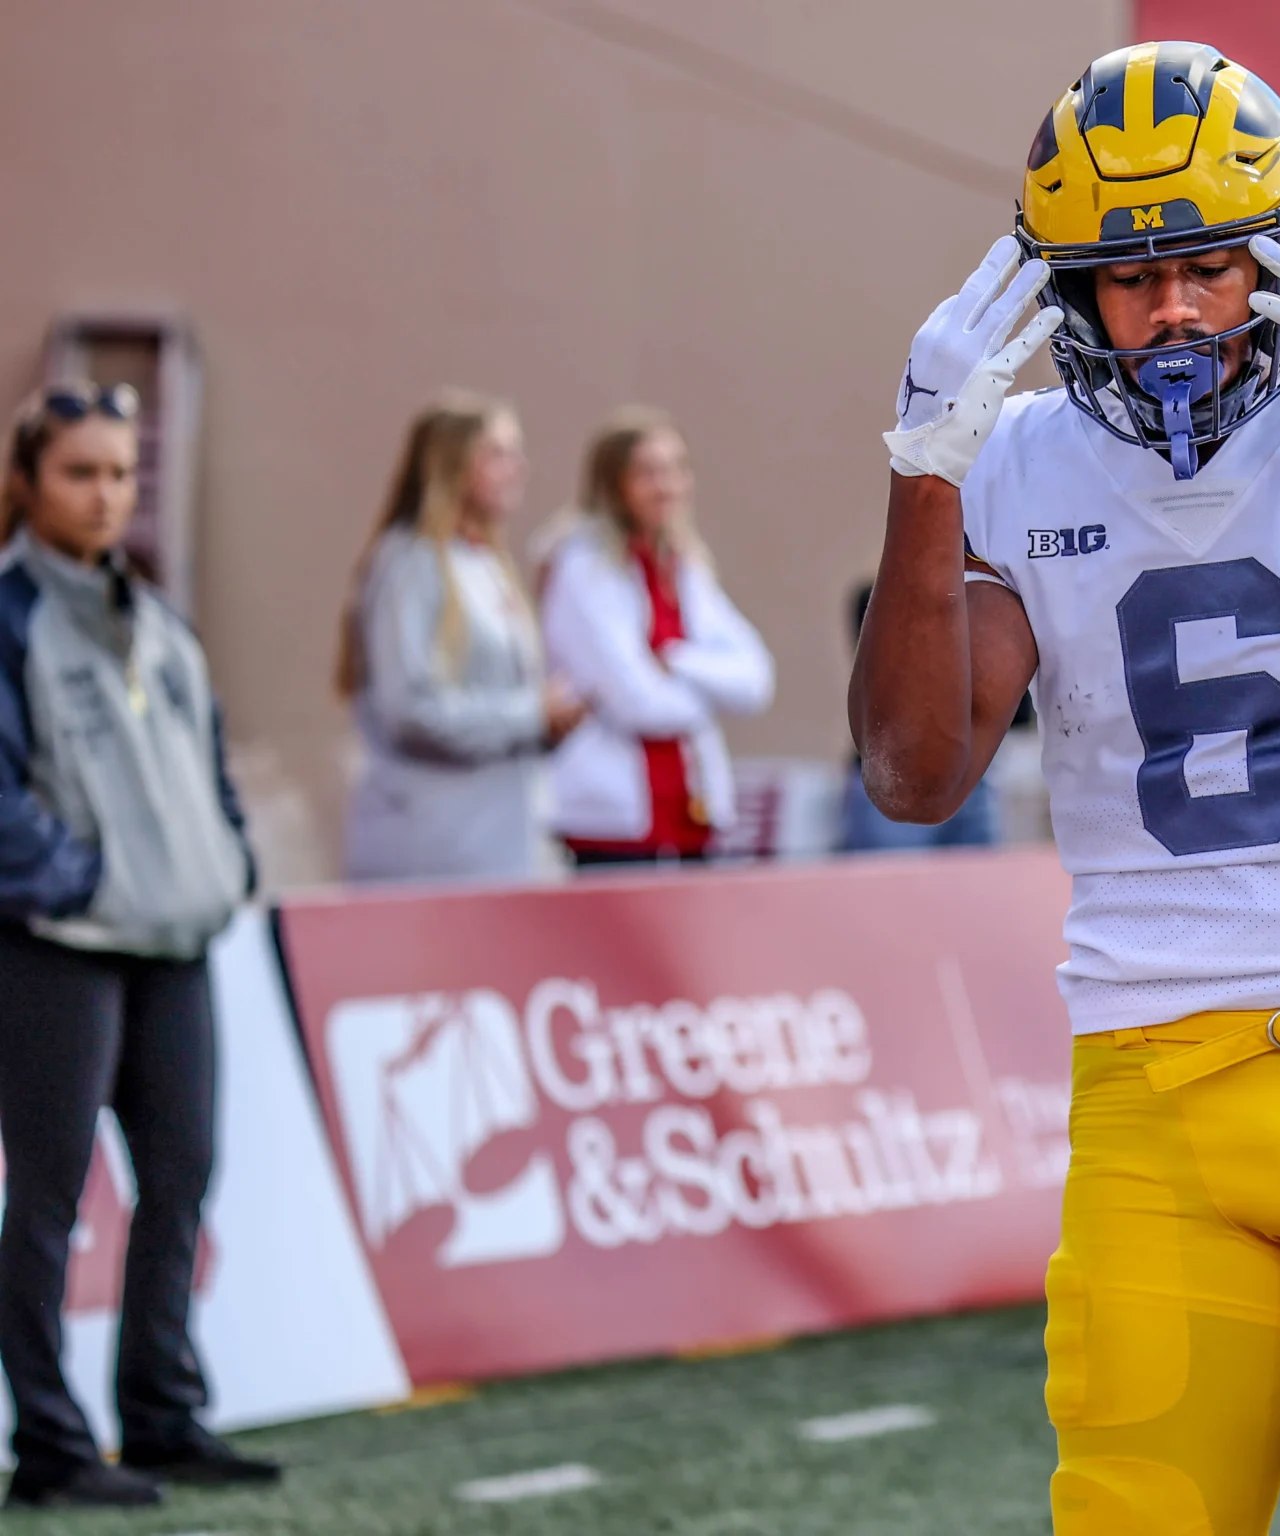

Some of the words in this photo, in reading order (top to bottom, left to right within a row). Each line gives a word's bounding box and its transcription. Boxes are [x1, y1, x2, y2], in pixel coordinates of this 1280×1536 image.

[1130, 205, 1165, 231] M
[1156, 357, 1194, 369] SHOCK
[526, 977, 872, 1112] Greene
